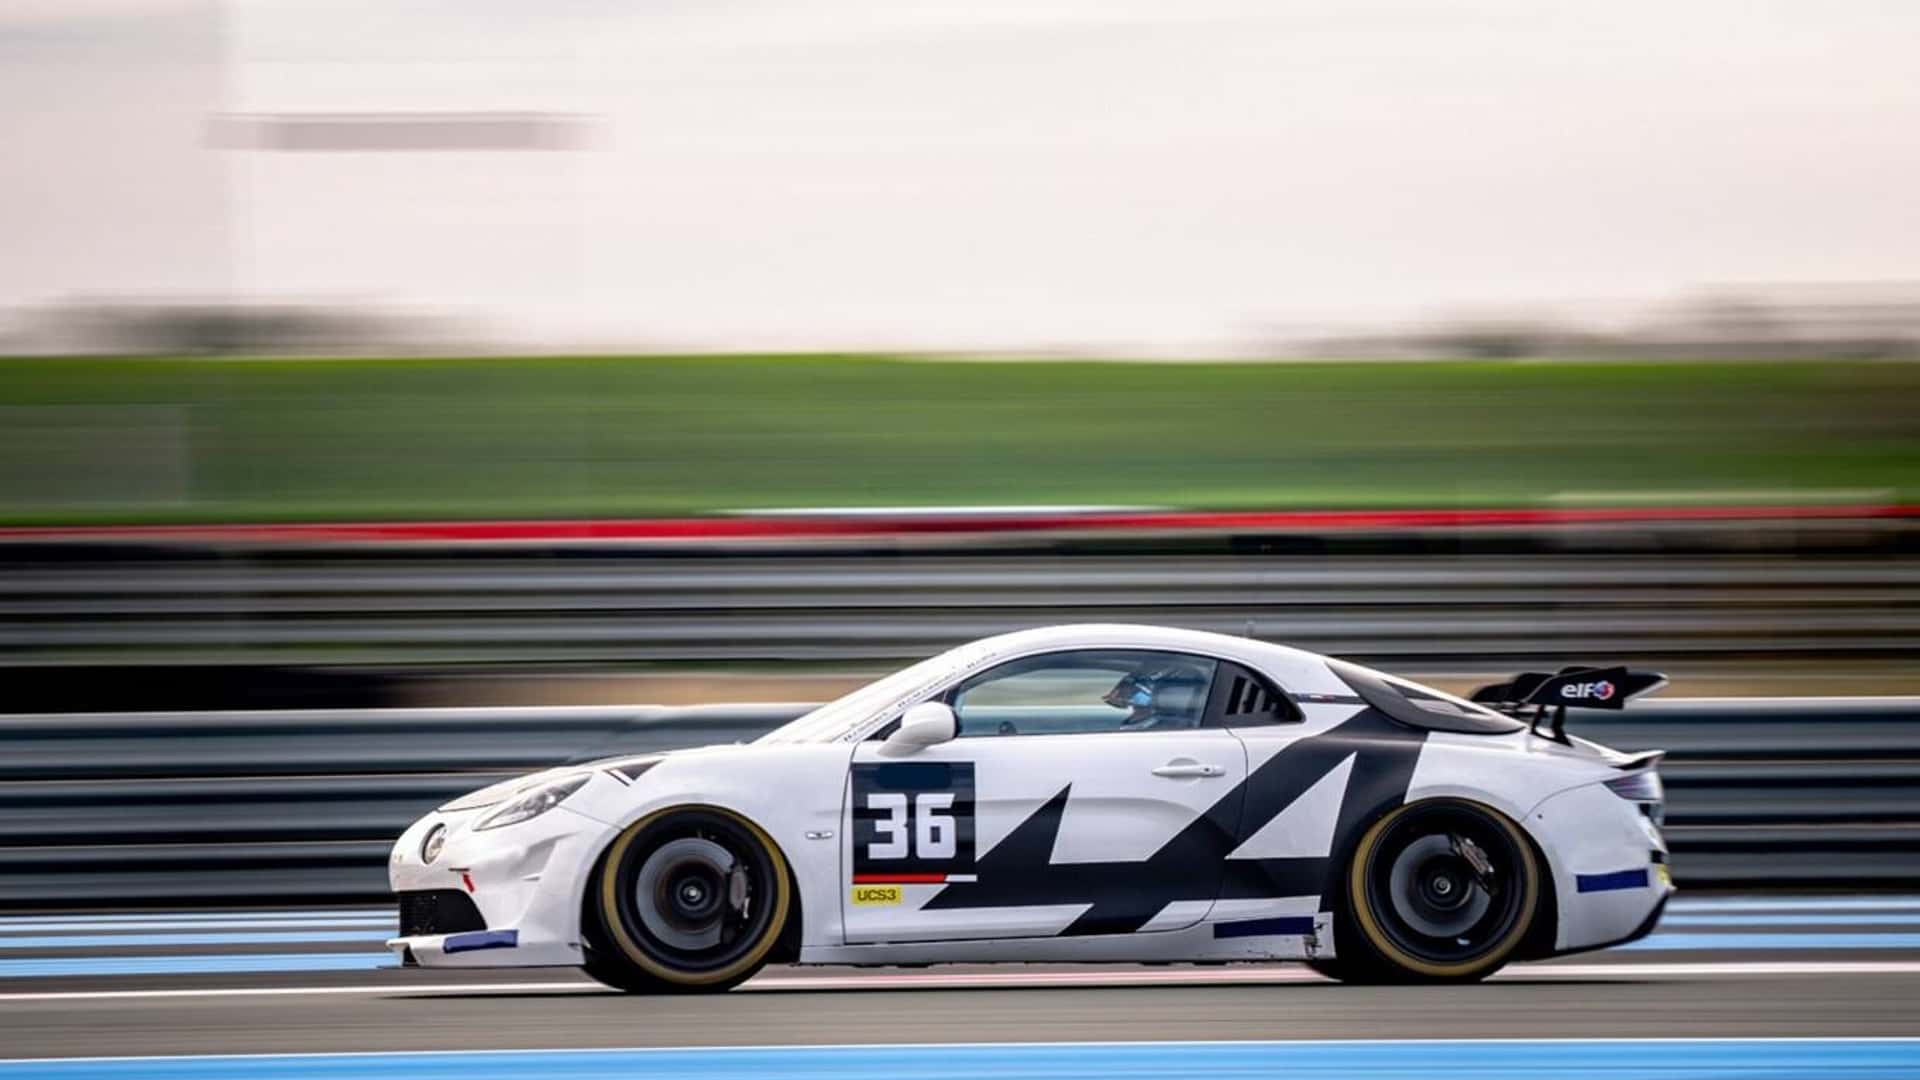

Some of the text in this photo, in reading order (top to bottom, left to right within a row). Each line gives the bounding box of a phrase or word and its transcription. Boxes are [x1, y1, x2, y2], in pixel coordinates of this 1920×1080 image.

[1561, 683, 1595, 698] elf
[867, 793, 956, 859] 36
[857, 889, 897, 901] UCS3
